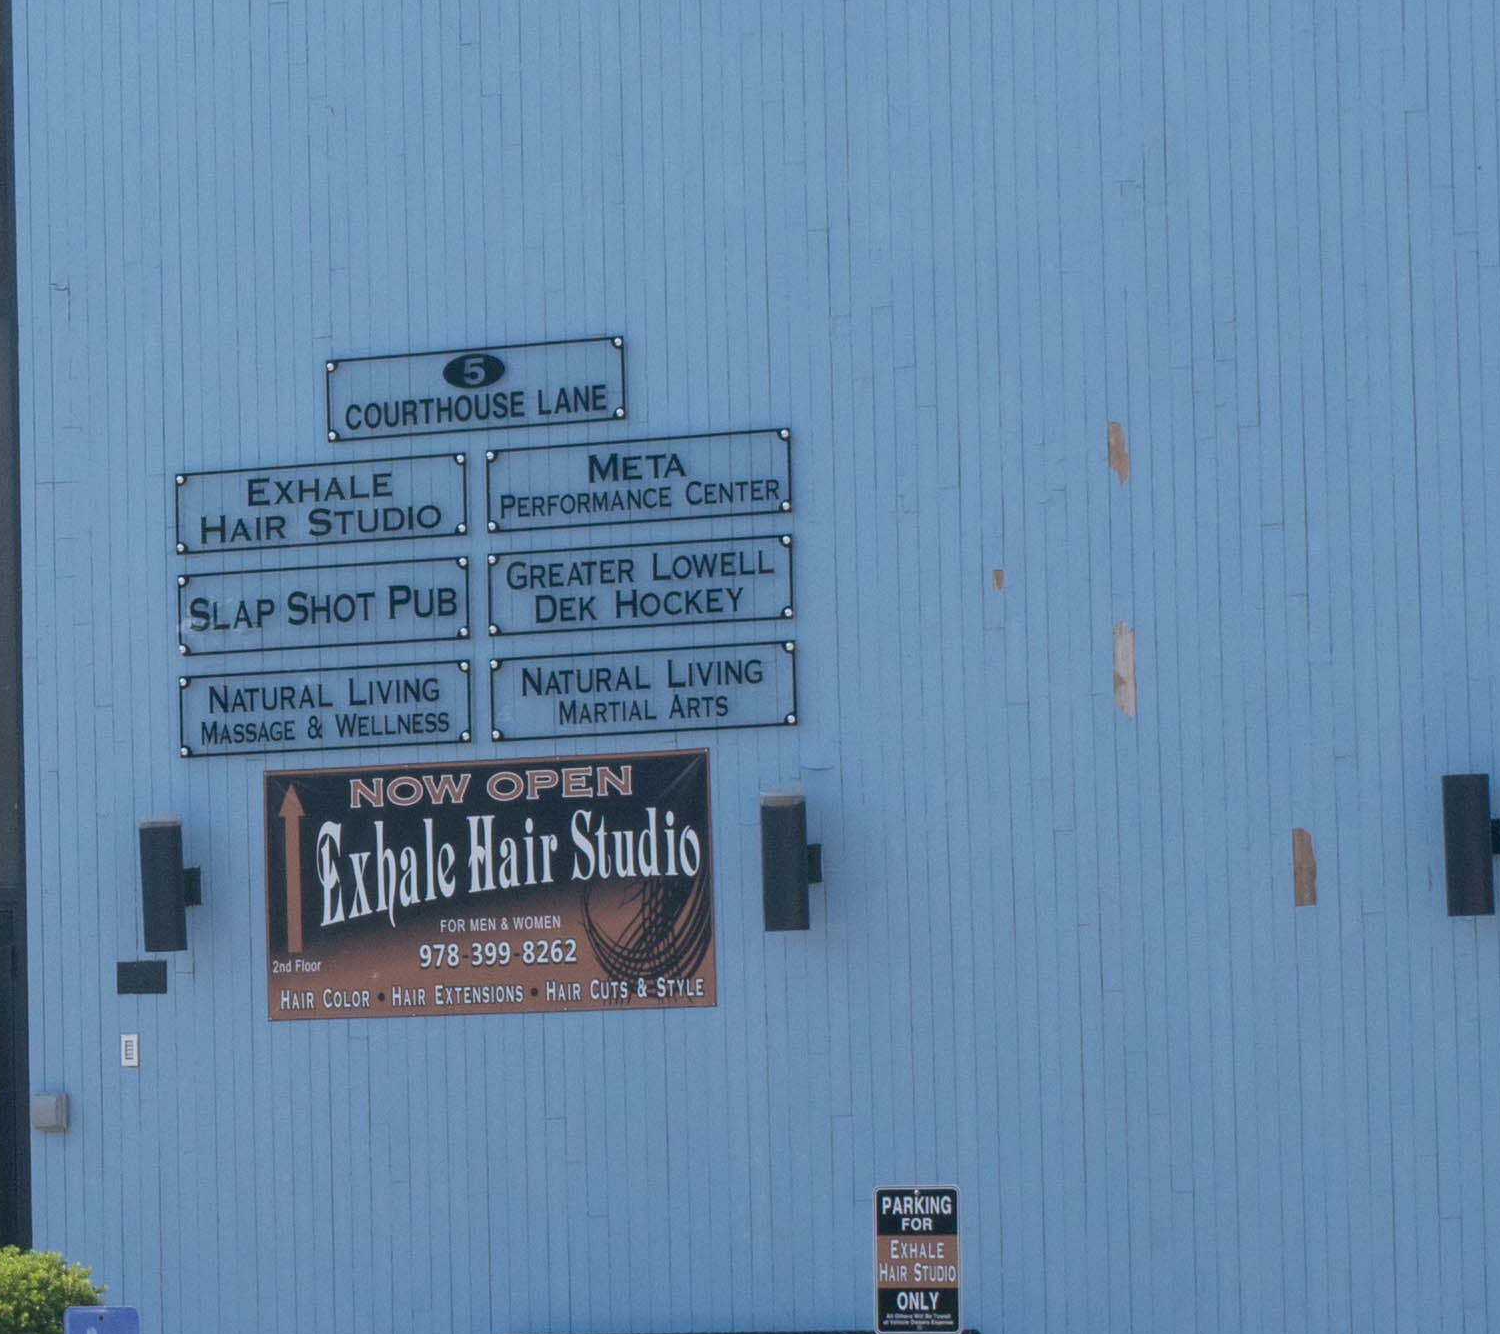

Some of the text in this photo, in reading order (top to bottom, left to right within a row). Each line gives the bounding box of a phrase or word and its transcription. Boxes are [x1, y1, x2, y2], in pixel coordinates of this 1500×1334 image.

[463, 359, 486, 383] 5
[345, 384, 608, 430] COURTHOUSE LANE
[589, 453, 686, 482] META
[247, 473, 393, 506] EXHALE
[500, 479, 780, 520] PERFORMANCE CENTER
[200, 505, 441, 544] HAIR STUDIO
[507, 551, 774, 591] GREATER LOWELL
[190, 585, 458, 632] SLAP SHOT PUB
[535, 587, 744, 624] DEK HOCKEY
[522, 659, 764, 696] NATURAL LIVING
[208, 677, 440, 714] NATURAL LIVING
[559, 693, 728, 726] MARTIAL ARTS
[201, 710, 450, 745] MASSAGE & WELLNESS
[350, 765, 632, 809] NOW OPEN
[316, 807, 700, 929] Exhale Hair Studio
[440, 915, 561, 933] FOR MEN & WOMEN
[272, 959, 321, 973] 2nd Floor
[419, 939, 577, 968] 978-399-8262
[280, 978, 704, 1010] HAIR COLOR HAIR EXTENSIONS HAIR CUTS & STYLE
[882, 1195, 952, 1215] PARKING
[901, 1217, 933, 1231] FOR
[890, 1239, 945, 1259] EXHALE
[879, 1262, 956, 1282] HAIR STUDIO
[896, 1291, 939, 1310] ONLY
